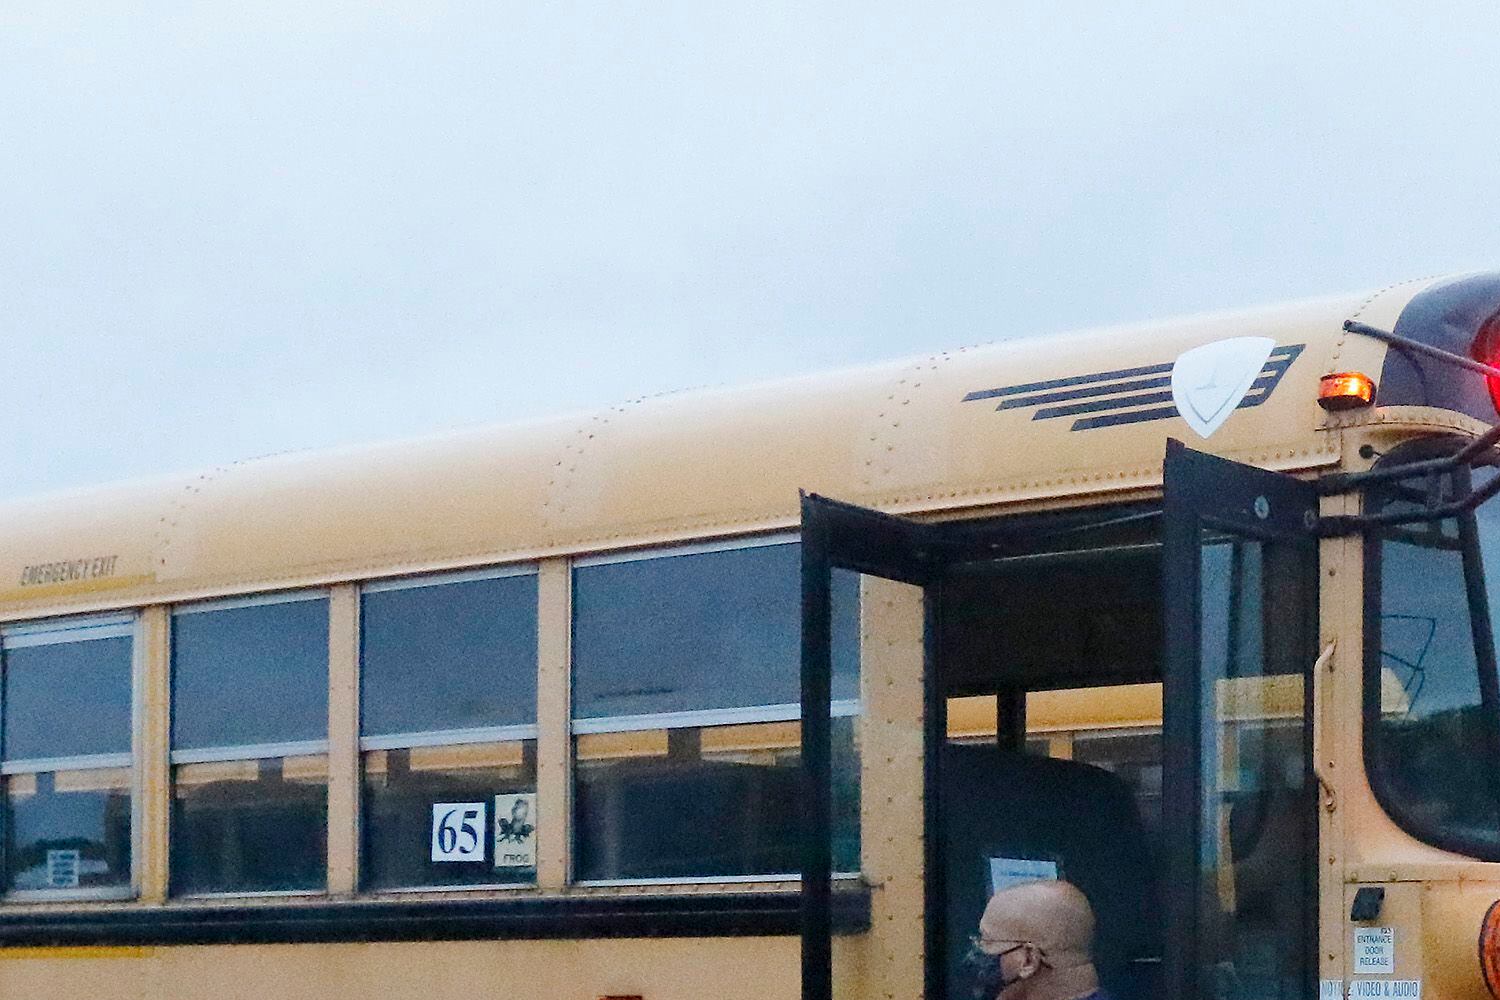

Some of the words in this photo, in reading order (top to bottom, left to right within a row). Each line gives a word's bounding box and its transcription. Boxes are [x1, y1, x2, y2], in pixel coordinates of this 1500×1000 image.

[21, 559, 89, 586] EMERGENCY
[92, 555, 118, 578] EXIT
[438, 809, 478, 854] 65
[503, 854, 529, 864] FROG
[1357, 935, 1391, 944] ENTRANCE
[1365, 946, 1384, 954] DOOR
[1359, 957, 1389, 966] RELEASE
[1357, 982, 1381, 996] VIDEO
[1384, 982, 1390, 996] &
[1393, 982, 1418, 997] AUDIO
